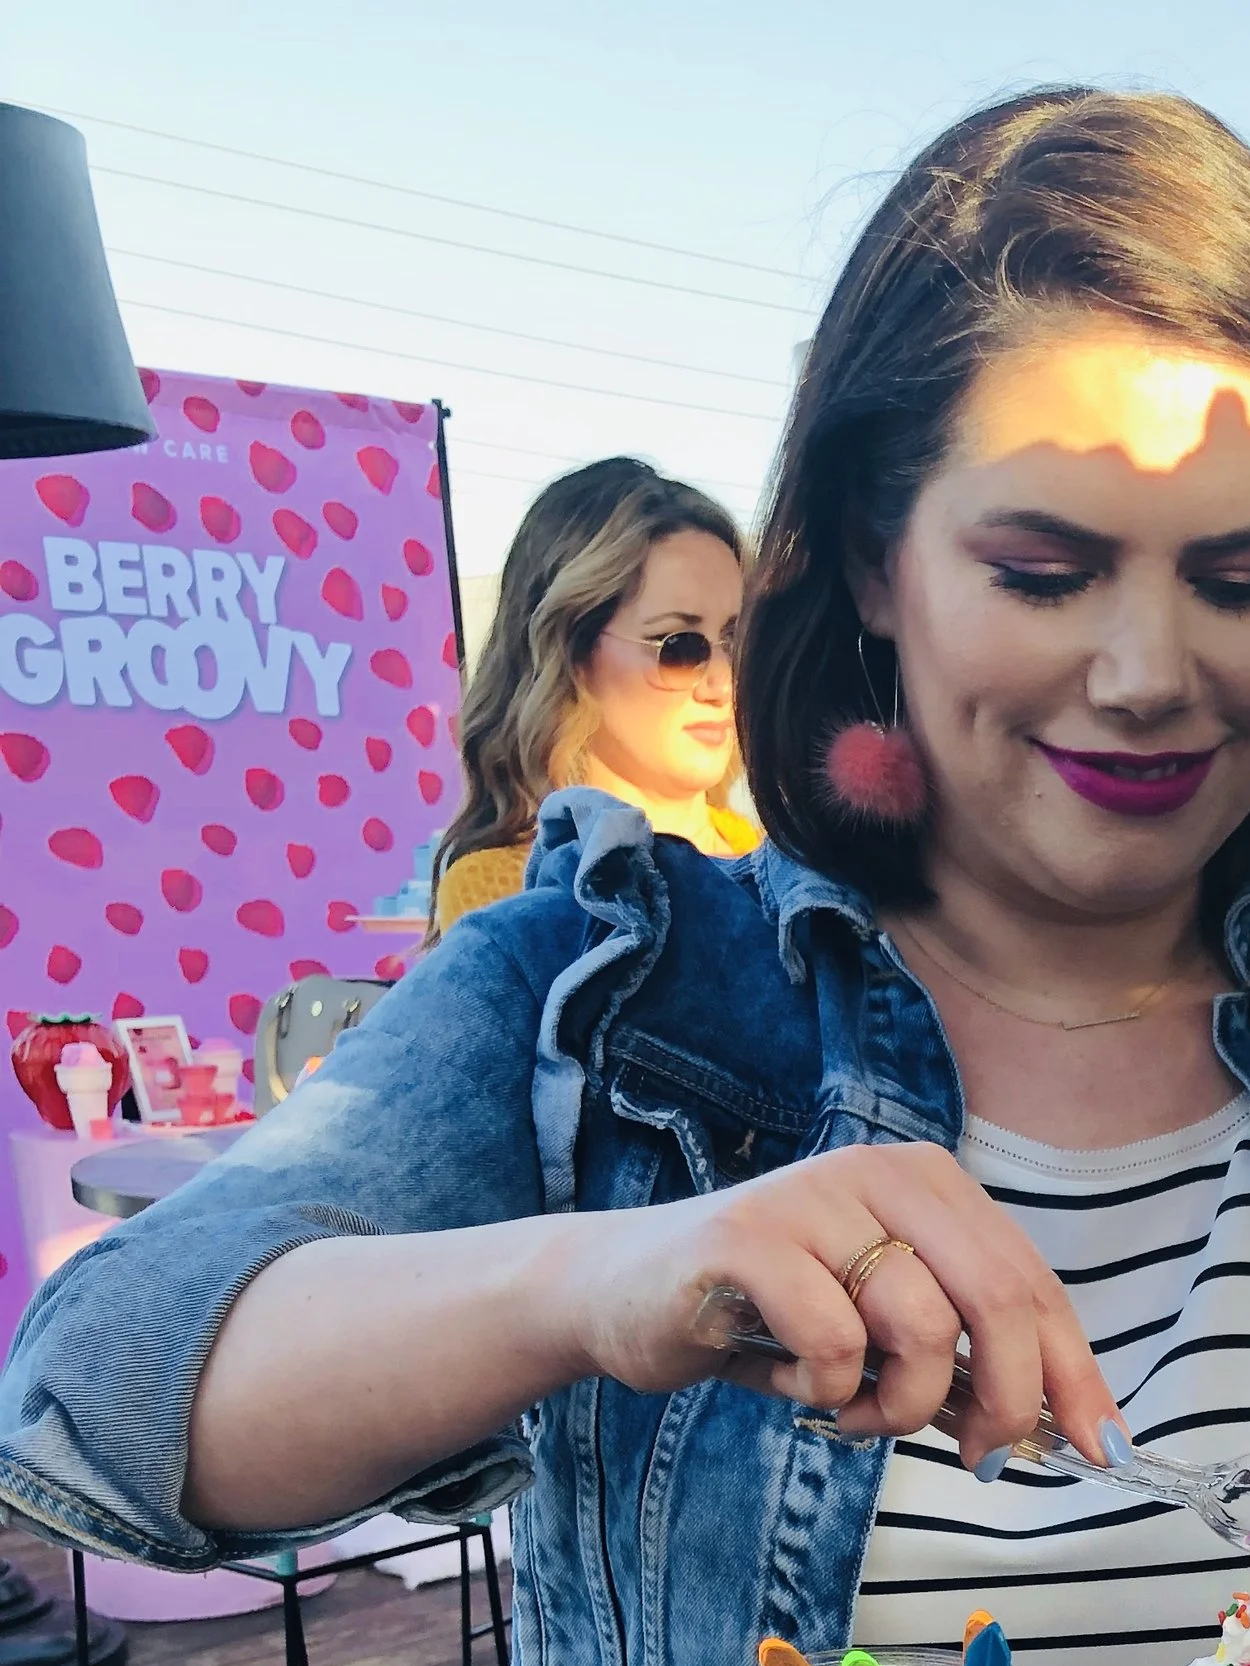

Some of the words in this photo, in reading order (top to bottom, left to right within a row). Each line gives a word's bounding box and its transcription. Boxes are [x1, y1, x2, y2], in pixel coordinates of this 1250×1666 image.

[163, 439, 229, 464] CARE
[42, 536, 286, 624] BERRY
[0, 613, 353, 720] GROOVY
